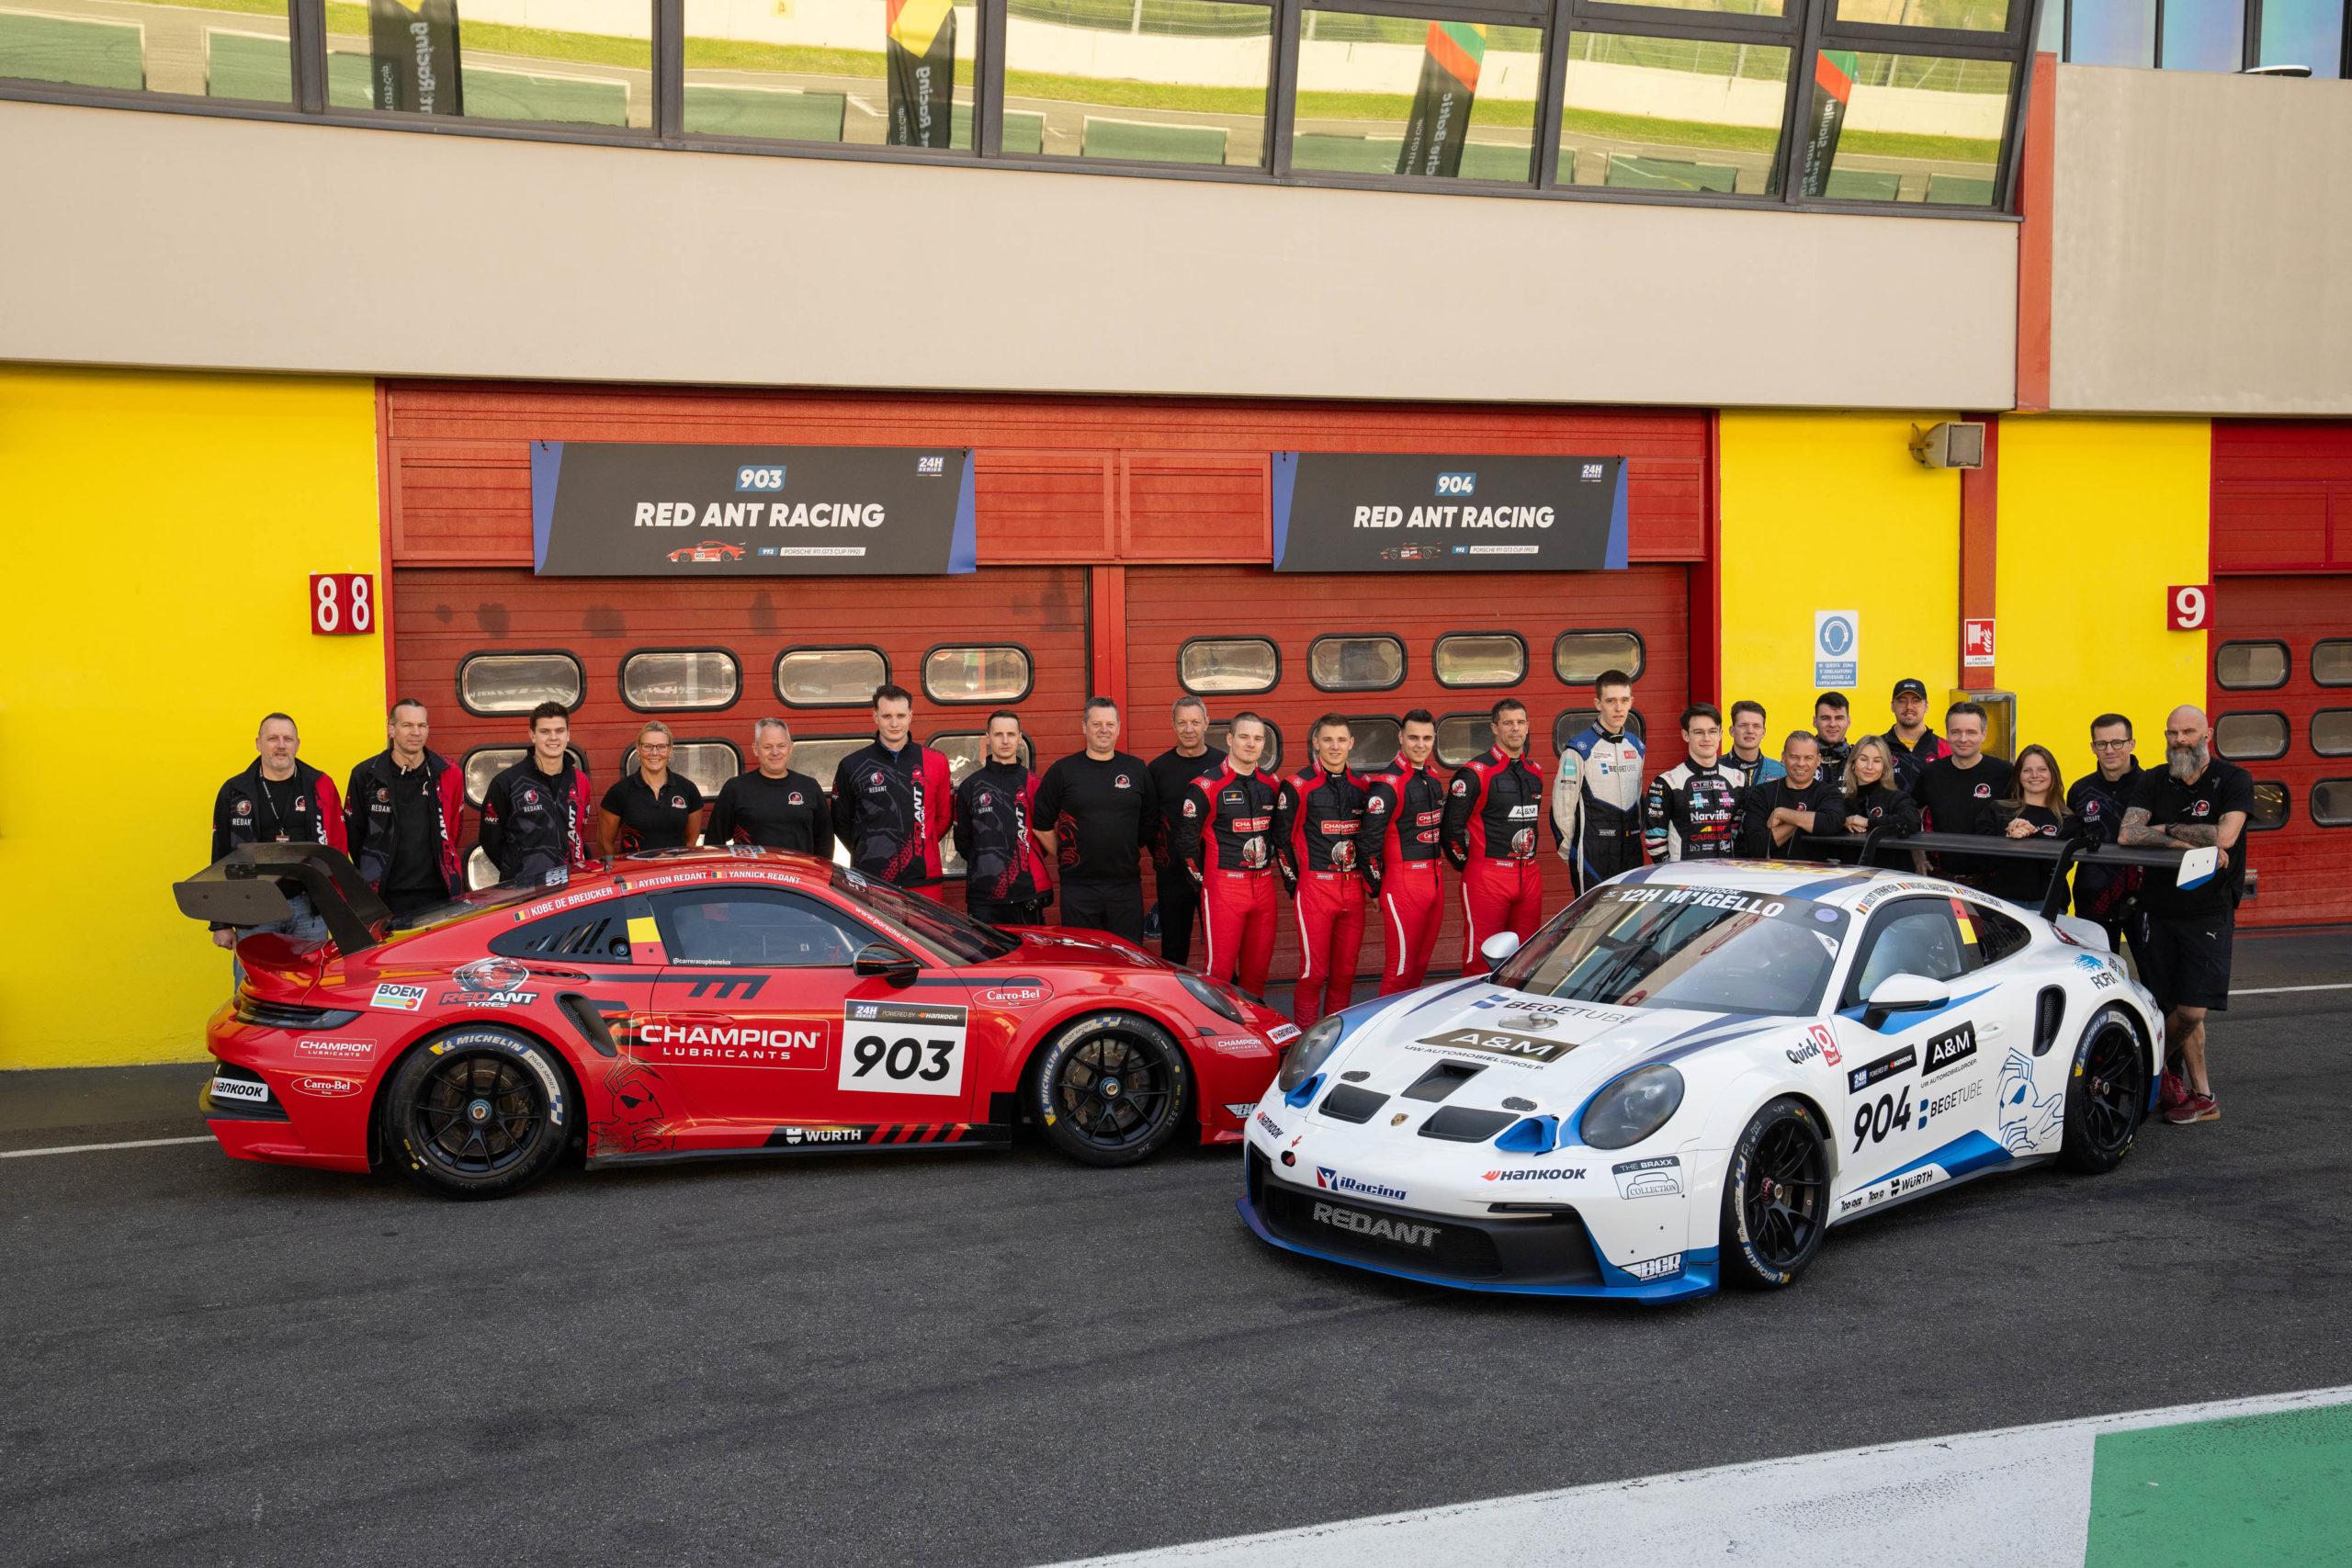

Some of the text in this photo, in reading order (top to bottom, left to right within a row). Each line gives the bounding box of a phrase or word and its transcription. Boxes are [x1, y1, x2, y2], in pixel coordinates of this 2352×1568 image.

[919, 457, 944, 468] 24H
[1582, 465, 1602, 474] 24H
[740, 468, 783, 489] 903
[1439, 476, 1473, 493] 904
[634, 502, 886, 528] RED ANT RACING
[1353, 505, 1555, 529] RED ANT RACING
[2176, 587, 2205, 627] 9
[530, 871, 801, 917] KOBE DE BREUCKER AYRTON REDANT YANNICK REDANT
[1617, 889, 1665, 903] 12H
[855, 906, 910, 944] www.porsche.nl
[378, 984, 424, 999] BOEM
[440, 991, 538, 1007] REDANT
[987, 989, 1040, 1000] Carro-Bel
[855, 1006, 877, 1015] 24H
[882, 1010, 909, 1018] POWERED
[1503, 1000, 1641, 1025] BEGETUBE
[300, 1041, 372, 1054] CHAMPION
[456, 1034, 525, 1054] MICHELIN
[640, 1024, 818, 1049] CHAMPION
[1217, 1039, 1261, 1047] CHAMPION
[1450, 1032, 1555, 1055] A&M
[1932, 1030, 1972, 1065] A&M
[662, 1047, 792, 1060] LUBRICANTS
[852, 1035, 956, 1081] 903
[1405, 1045, 1545, 1071] UW AUTOMOBIELGROEP
[1785, 1038, 1821, 1065] Quick
[303, 1078, 351, 1091] Carro-Bel
[1042, 1050, 1059, 1105] MICHELIN
[1854, 1069, 1867, 1085] 24H
[1930, 1078, 1984, 1118] BEGETUBE
[1852, 1084, 1912, 1155] 904
[806, 1127, 862, 1141] WÜRTH
[1619, 1158, 1674, 1172] THE BRAXX
[1339, 1176, 1408, 1201] iRacing
[1629, 1184, 1677, 1196] COLLECTION
[1902, 1169, 1934, 1191] WÜRTH
[1313, 1201, 1442, 1247] REDANT
[1641, 1253, 1681, 1278] BCR
[1744, 1245, 1781, 1281] MICHELIN
